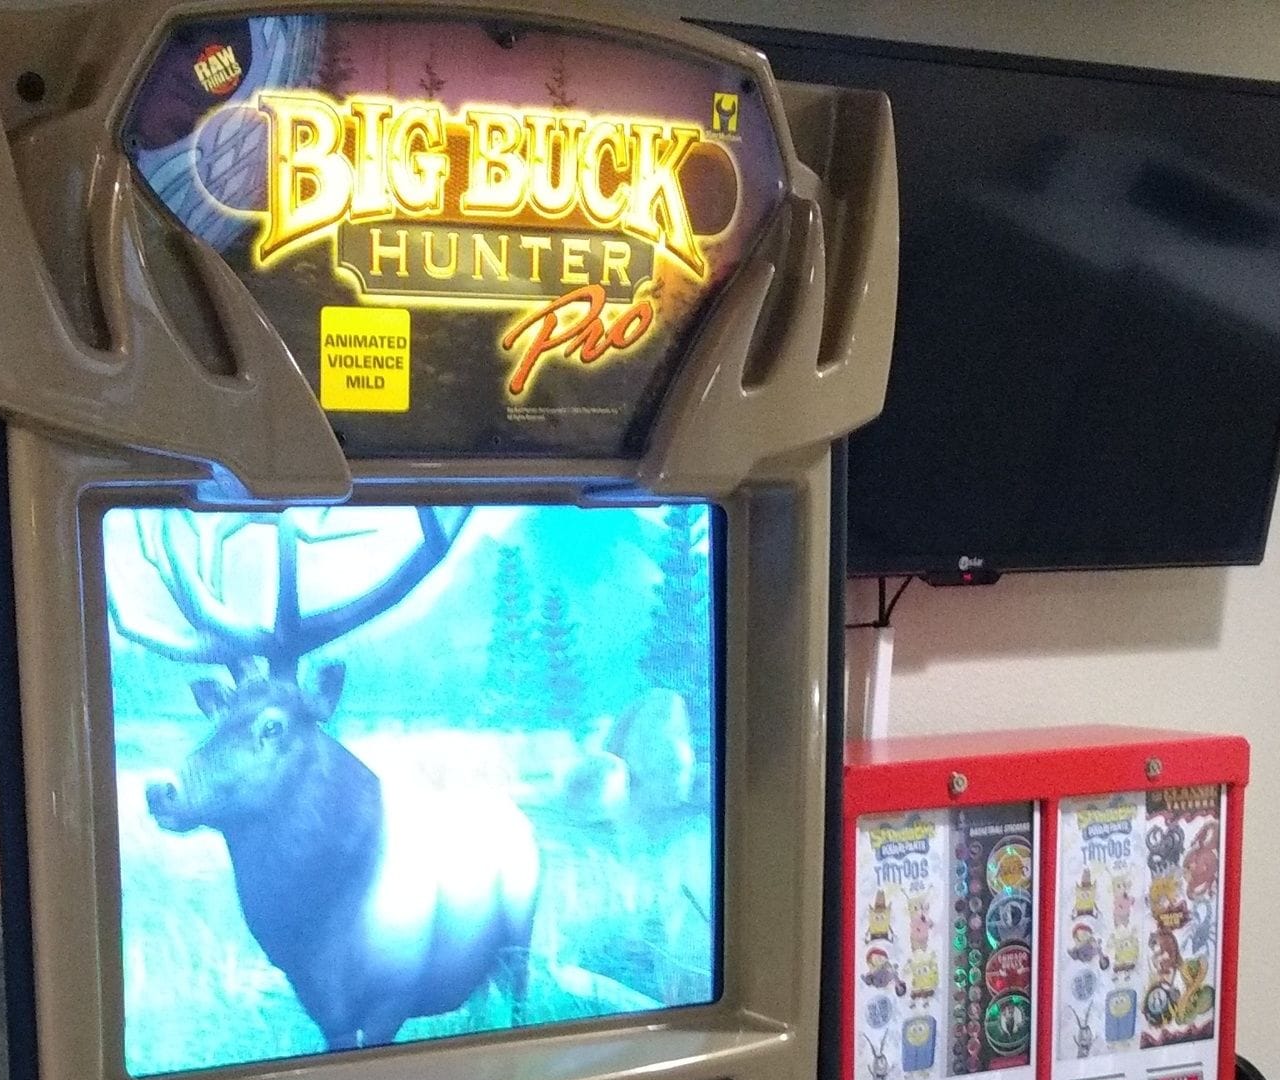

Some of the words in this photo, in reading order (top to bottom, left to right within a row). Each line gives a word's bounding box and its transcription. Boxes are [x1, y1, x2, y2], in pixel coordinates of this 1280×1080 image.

[194, 45, 237, 81] RAW
[258, 95, 451, 262] BIG
[462, 110, 705, 277] BUCK
[369, 227, 633, 287] HUNTER
[324, 333, 407, 349] ANIMATED
[502, 286, 654, 396] Pro
[328, 354, 404, 370] VIOLENCE
[346, 374, 385, 389] MILD
[1081, 838, 1131, 865] TATTOOS
[874, 857, 929, 887] TATTOOS
